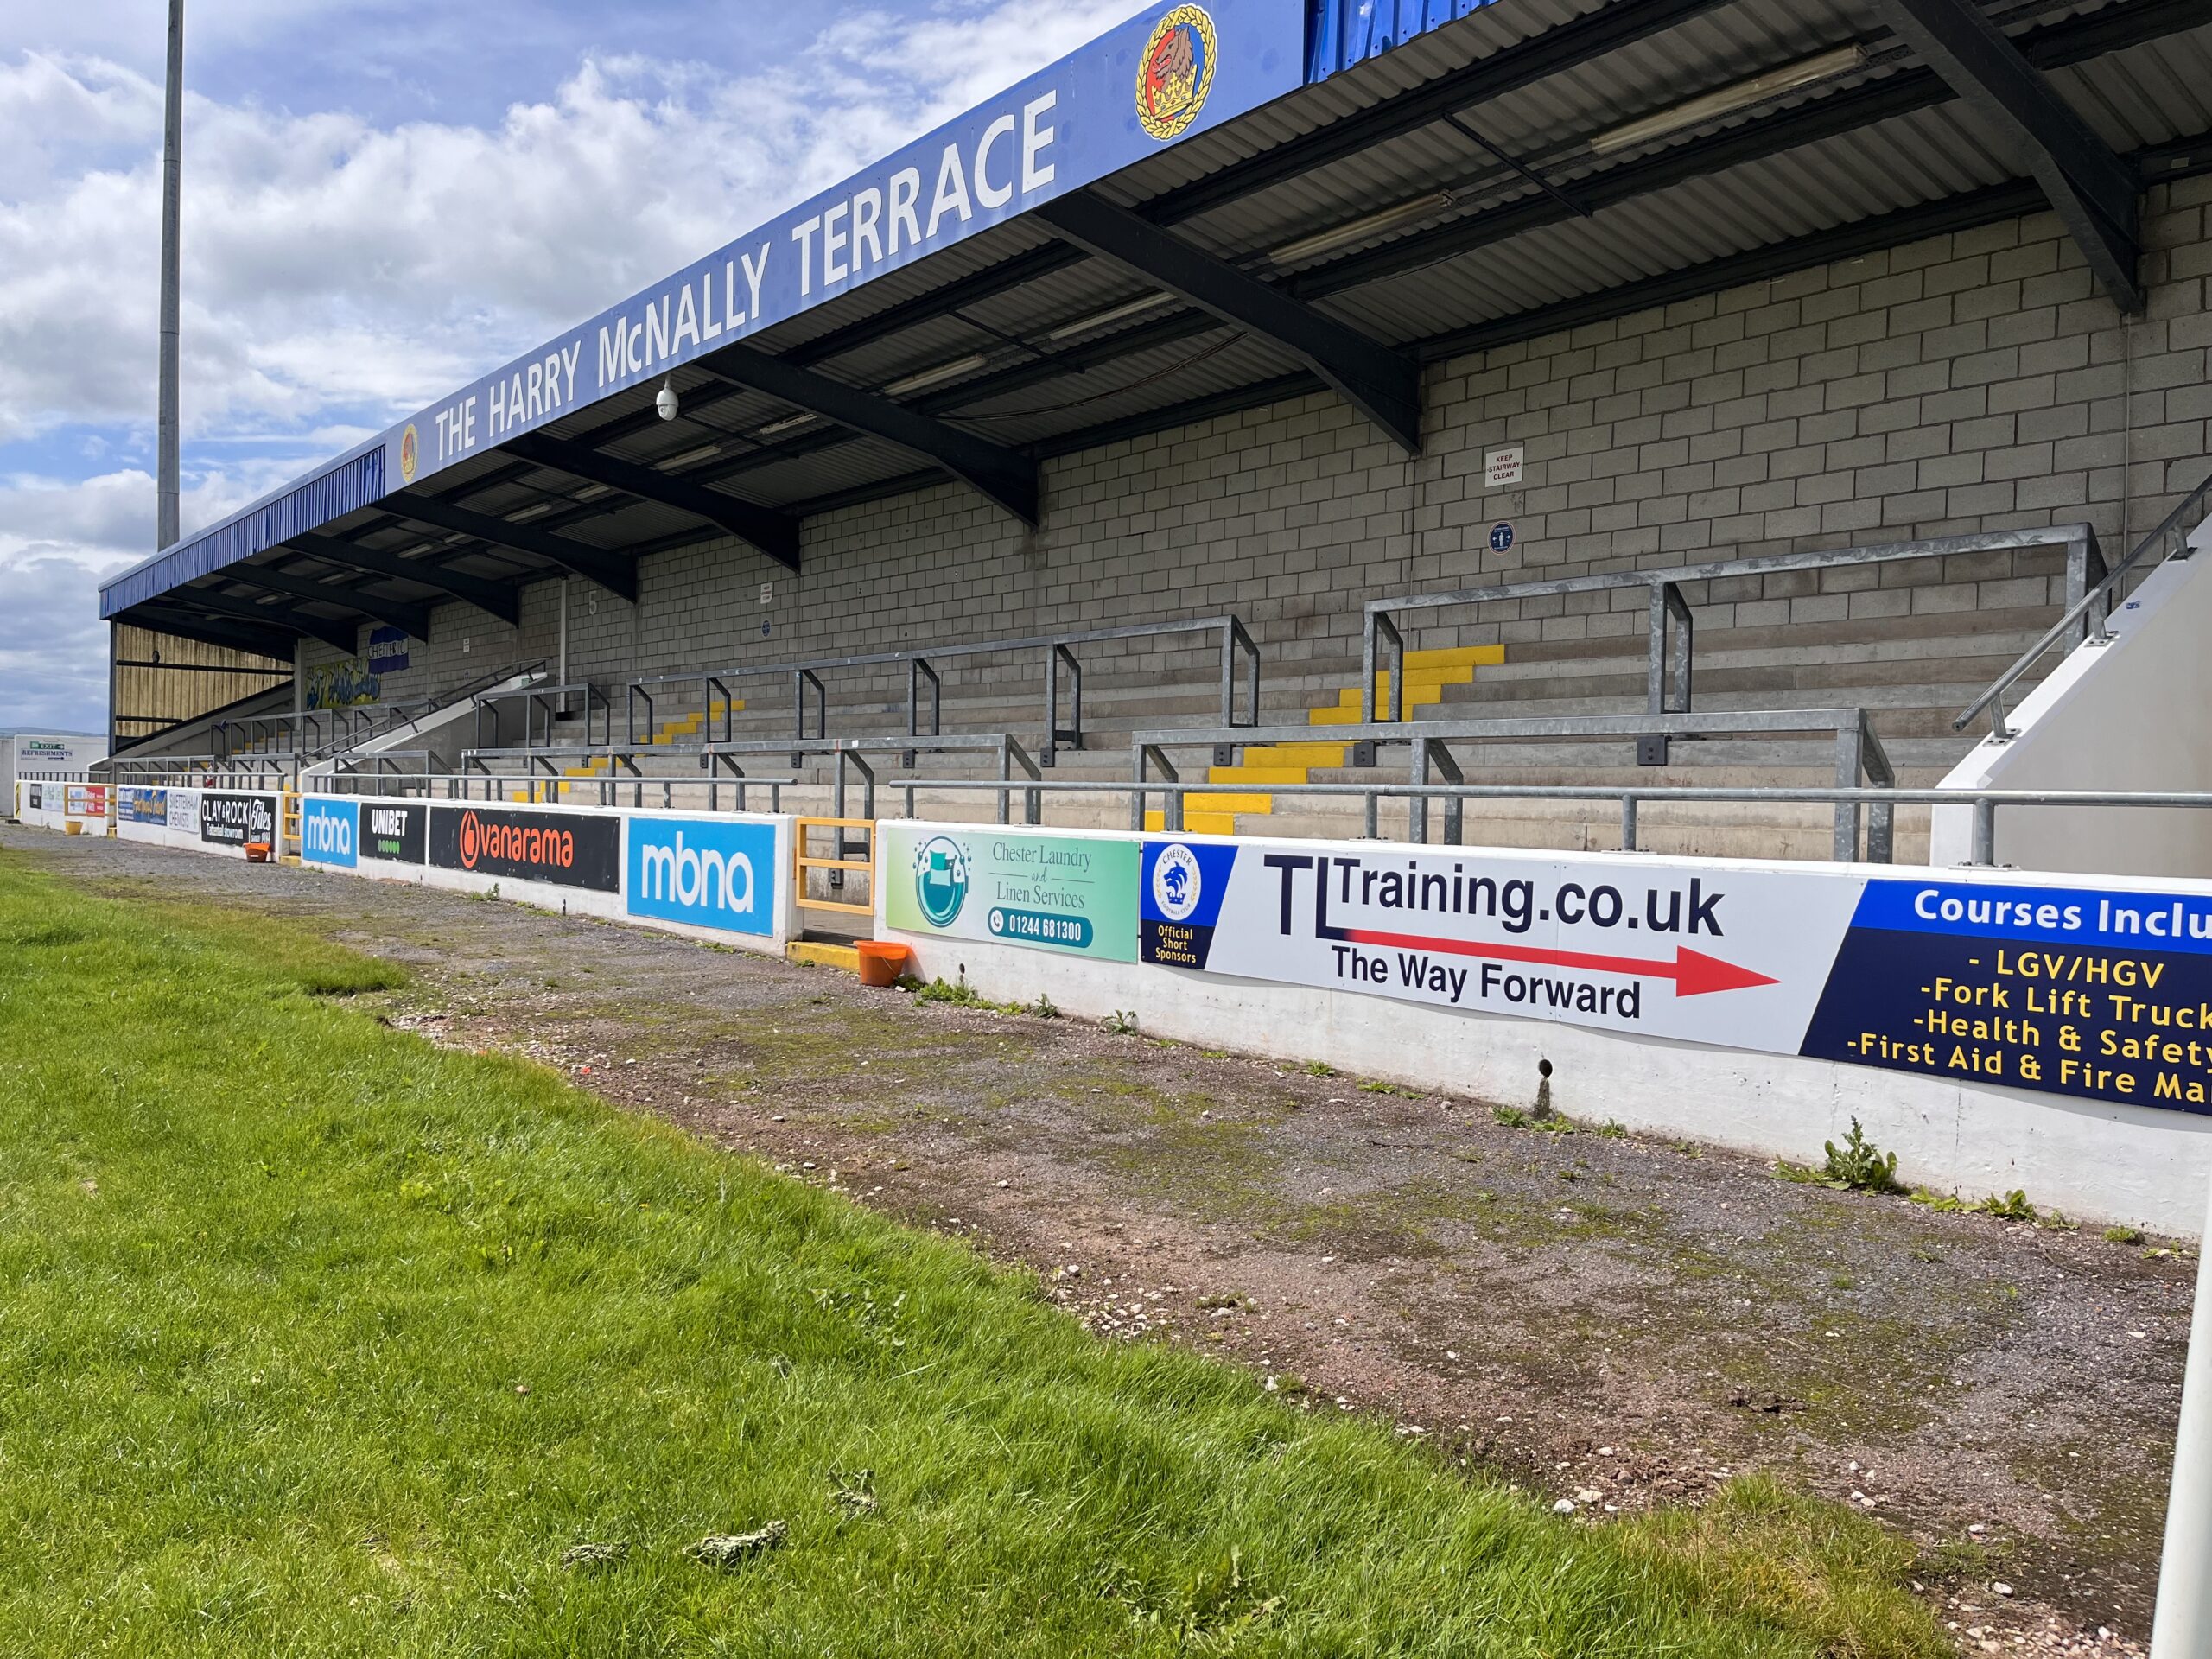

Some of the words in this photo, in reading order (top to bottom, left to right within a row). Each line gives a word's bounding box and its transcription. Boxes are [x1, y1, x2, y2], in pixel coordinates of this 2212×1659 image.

[435, 394, 476, 460] THE
[488, 340, 582, 437] HARRY
[598, 241, 771, 388] McNALLY
[791, 89, 1058, 296] TERRACE
[1496, 454, 1513, 463] KEEP
[1493, 471, 1515, 480] CLEAR
[588, 590, 597, 615] 5
[202, 799, 222, 822] CLAY
[226, 800, 249, 824] ROCK
[251, 798, 271, 831] Tiles
[372, 809, 408, 836] UNIBET
[308, 806, 350, 855] mbna
[480, 823, 573, 868] vanarama
[993, 842, 1037, 864] Chester
[1039, 845, 1092, 873] Laundry
[1162, 849, 1192, 866] CHESTER
[642, 830, 753, 913] mbna
[1032, 867, 1047, 883] and
[997, 881, 1030, 903] Linen
[1033, 885, 1085, 909] Services
[1161, 900, 1180, 916] FOOTBALL
[1914, 888, 2082, 931] Courses
[1009, 914, 1039, 936] 01244
[1043, 918, 1081, 941] 681300
[1158, 925, 1193, 940] Official
[1155, 947, 1197, 963] Sponsors
[1162, 938, 1188, 950] Short
[1332, 945, 1389, 984] The
[1398, 954, 1468, 1003] Way
[1481, 963, 1642, 1020] Forward
[1997, 950, 2164, 988] LGV/HGV
[2027, 986, 2092, 1018] Lift
[2058, 1026, 2081, 1052] &
[1948, 1045, 2003, 1076] Aid
[2019, 1053, 2042, 1081] &
[2060, 1059, 2136, 1094] Fire
[2153, 1071, 2212, 1104] Ma
